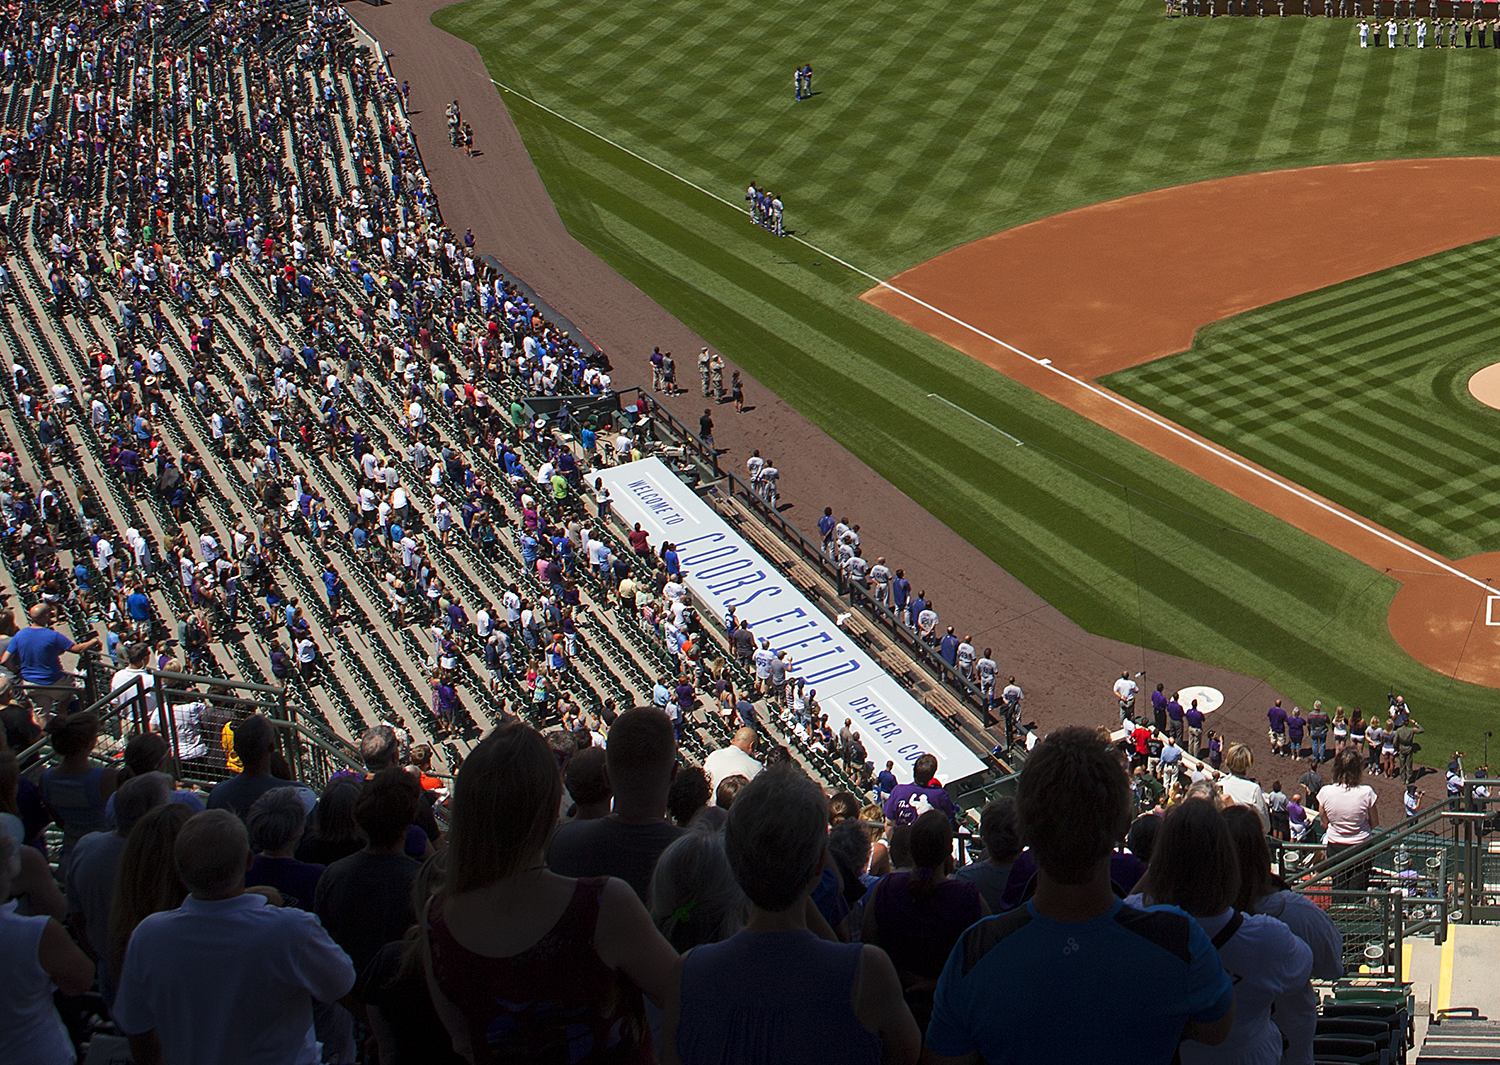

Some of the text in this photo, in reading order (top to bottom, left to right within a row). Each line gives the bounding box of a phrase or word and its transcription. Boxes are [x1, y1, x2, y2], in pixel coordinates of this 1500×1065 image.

[627, 478, 685, 527] WELCOME TO
[675, 532, 861, 687] COORS FIELD
[848, 695, 903, 746] DENVER,
